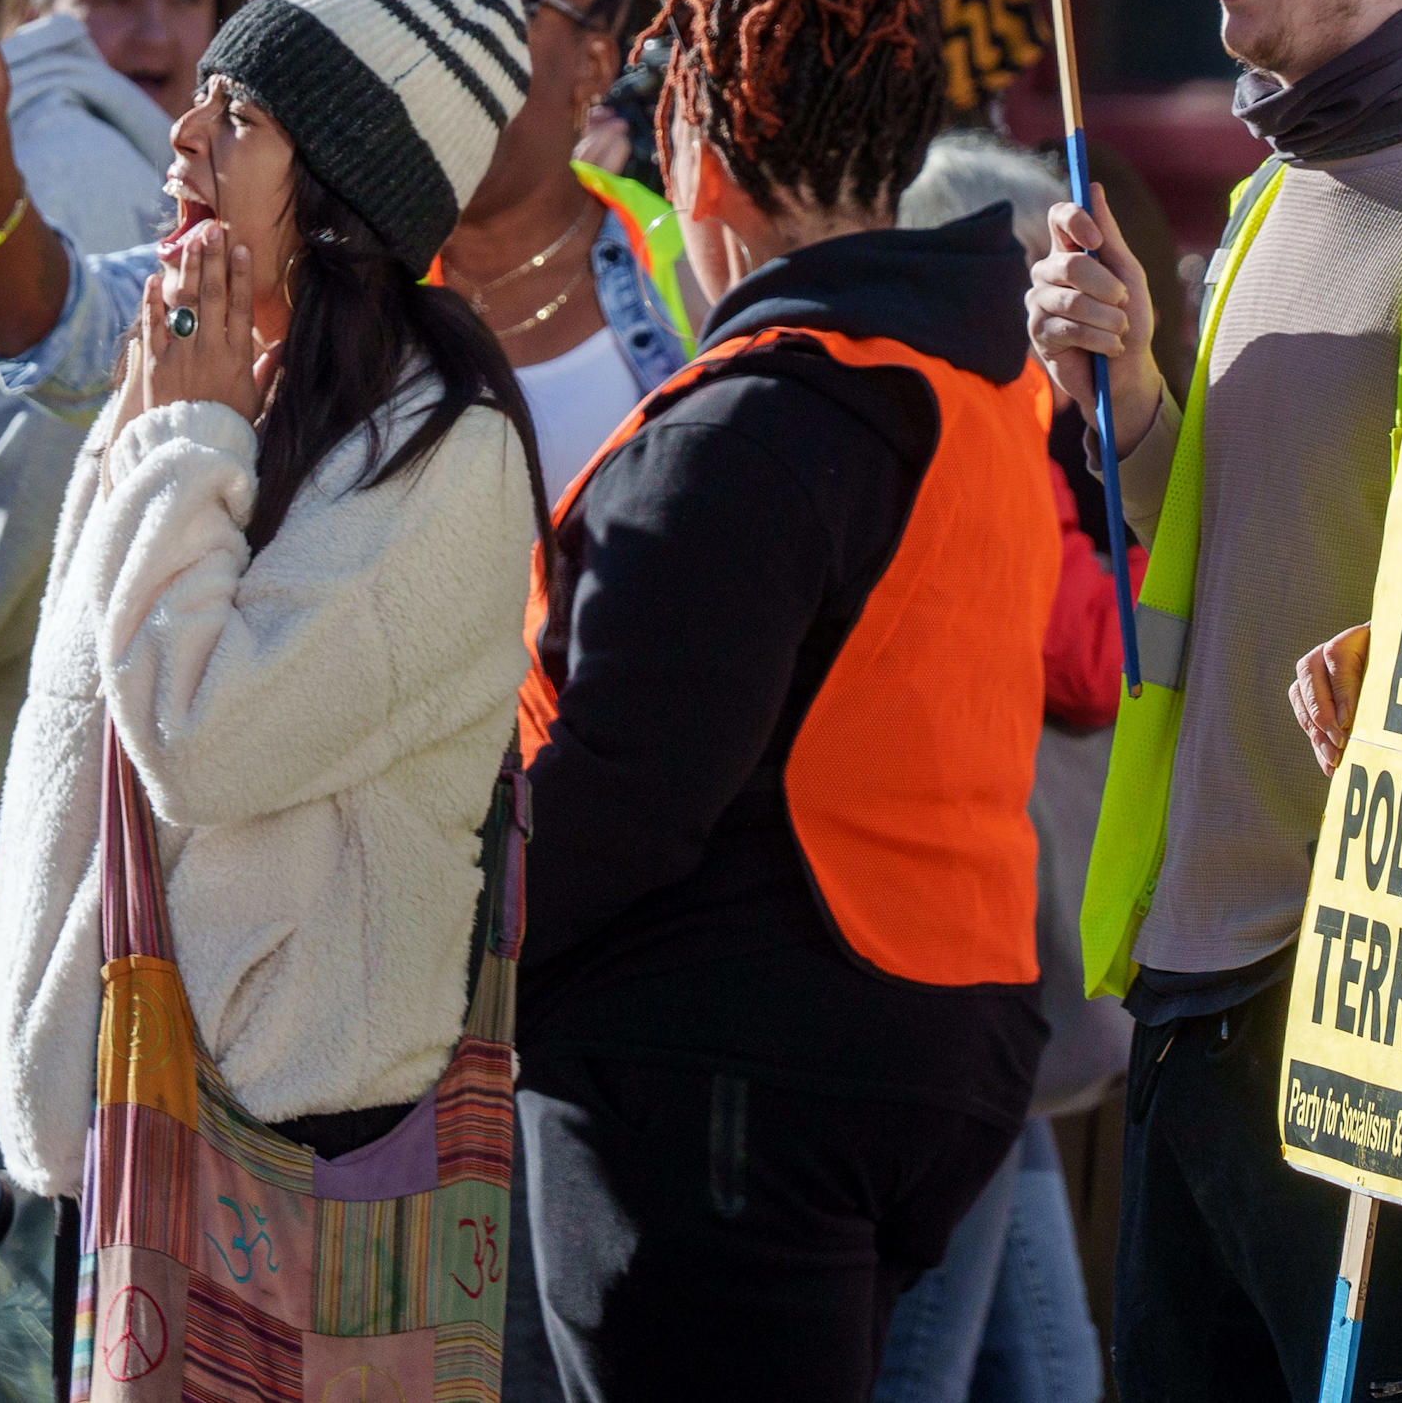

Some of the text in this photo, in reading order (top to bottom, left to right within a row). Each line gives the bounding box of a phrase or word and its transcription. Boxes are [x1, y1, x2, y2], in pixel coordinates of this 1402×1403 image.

[1288, 1076, 1323, 1143] Party
[1322, 1086, 1341, 1139] for
[1339, 1090, 1392, 1155] Socialism
